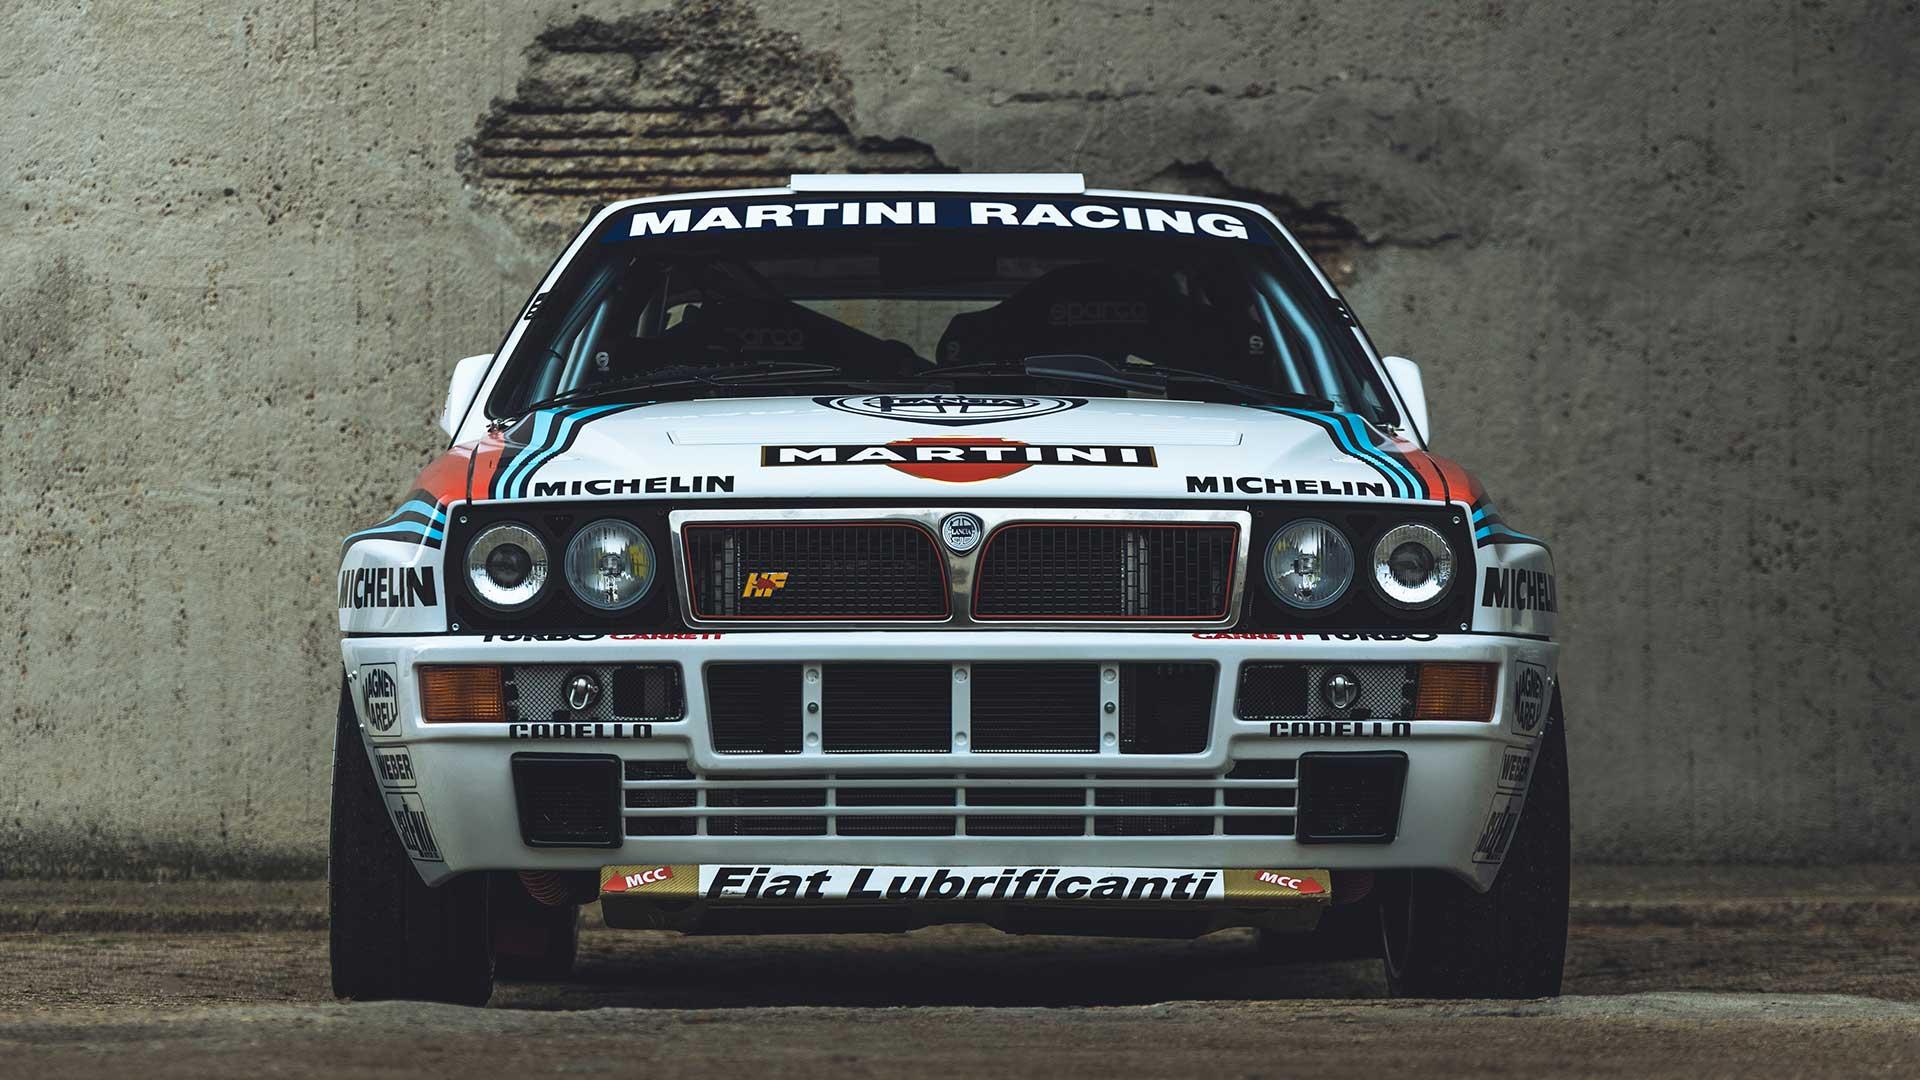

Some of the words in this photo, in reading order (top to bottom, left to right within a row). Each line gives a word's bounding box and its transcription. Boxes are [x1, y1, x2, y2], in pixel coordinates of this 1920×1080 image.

[629, 202, 936, 237] MARTINI
[970, 202, 1250, 239] RACING
[779, 447, 1138, 463] MARTINI
[534, 475, 735, 496] MICHELIN
[1186, 476, 1385, 496] MICHELIN
[339, 566, 438, 609] MICHELIN
[742, 572, 789, 598] HF
[509, 723, 652, 739] CARELLO
[1269, 722, 1411, 738] CARELLO
[376, 753, 414, 780] WEBER
[625, 867, 668, 888] MCC
[706, 866, 832, 899] Fiat
[846, 867, 1217, 900] Lubrificanti
[1259, 870, 1303, 890] MCC
